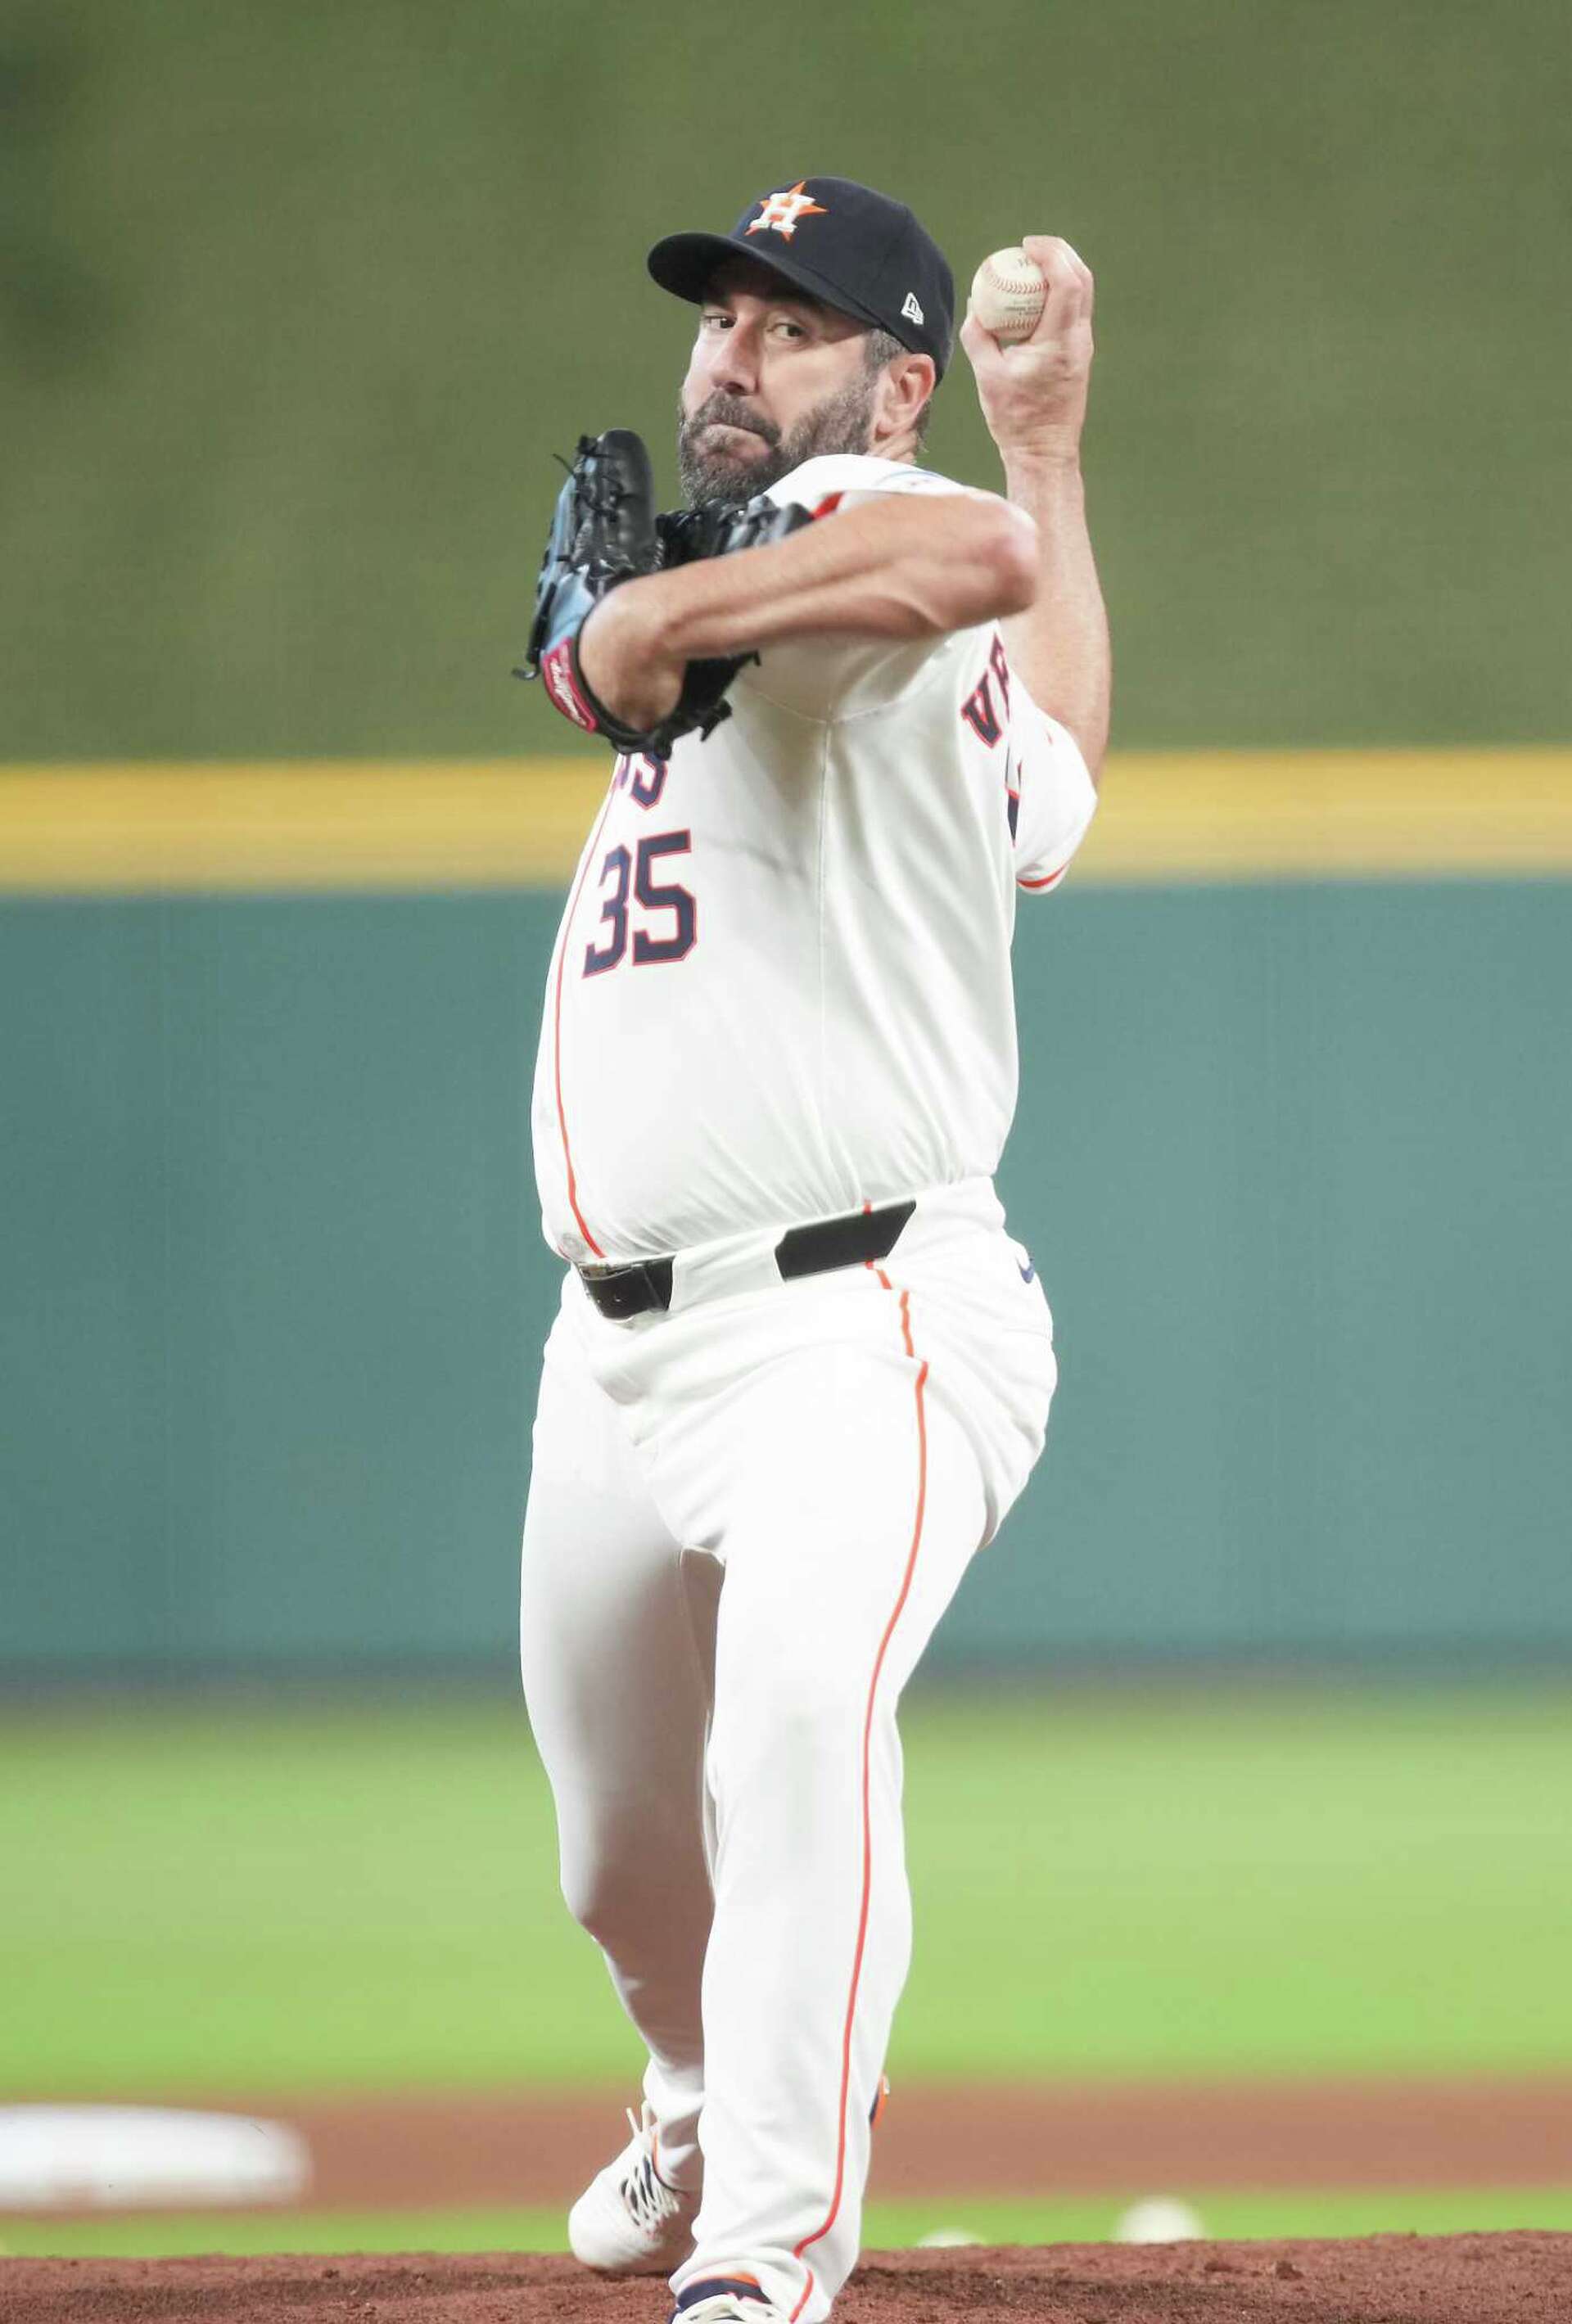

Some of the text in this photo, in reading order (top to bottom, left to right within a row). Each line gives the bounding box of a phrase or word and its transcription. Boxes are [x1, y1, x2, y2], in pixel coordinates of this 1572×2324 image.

[749, 191, 816, 233] H
[615, 751, 667, 810] S
[582, 828, 698, 978] 35
